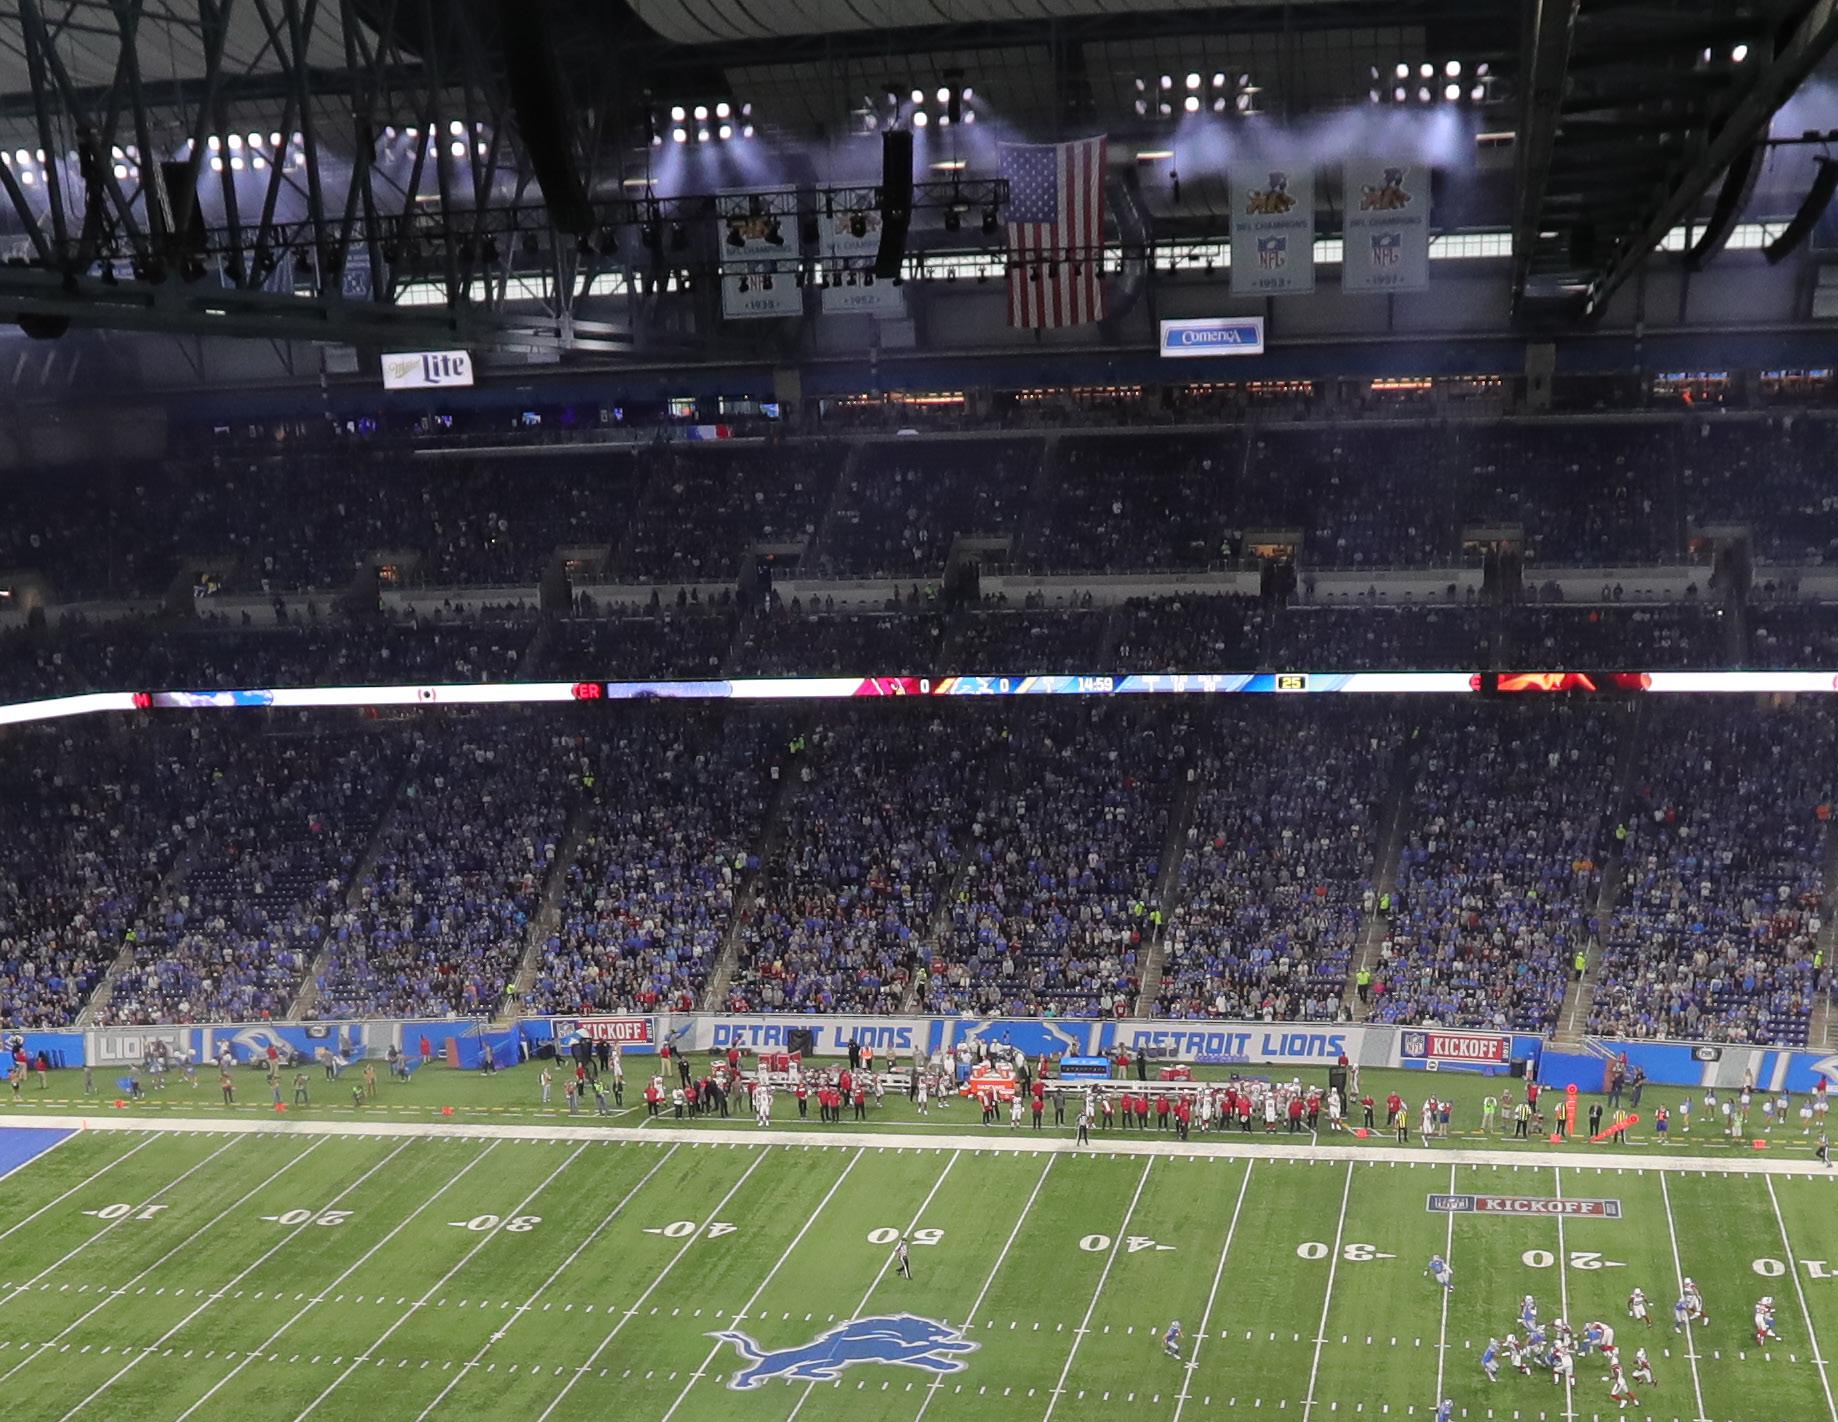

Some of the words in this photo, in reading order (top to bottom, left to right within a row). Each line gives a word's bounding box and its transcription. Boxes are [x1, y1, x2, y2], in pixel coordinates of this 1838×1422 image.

[1259, 250, 1285, 268] NFL
[420, 353, 464, 384] Lite
[1079, 677, 1113, 692] 14:59
[1281, 676, 1301, 689] 25
[713, 1024, 825, 1047] DETRT
[835, 1025, 913, 1049] LIONS
[1133, 1030, 1251, 1055] DETROIT
[1261, 1033, 1346, 1057] LIONS
[1433, 1036, 1498, 1058] KICKOFF
[1485, 1199, 1595, 1214] KICKOFF
